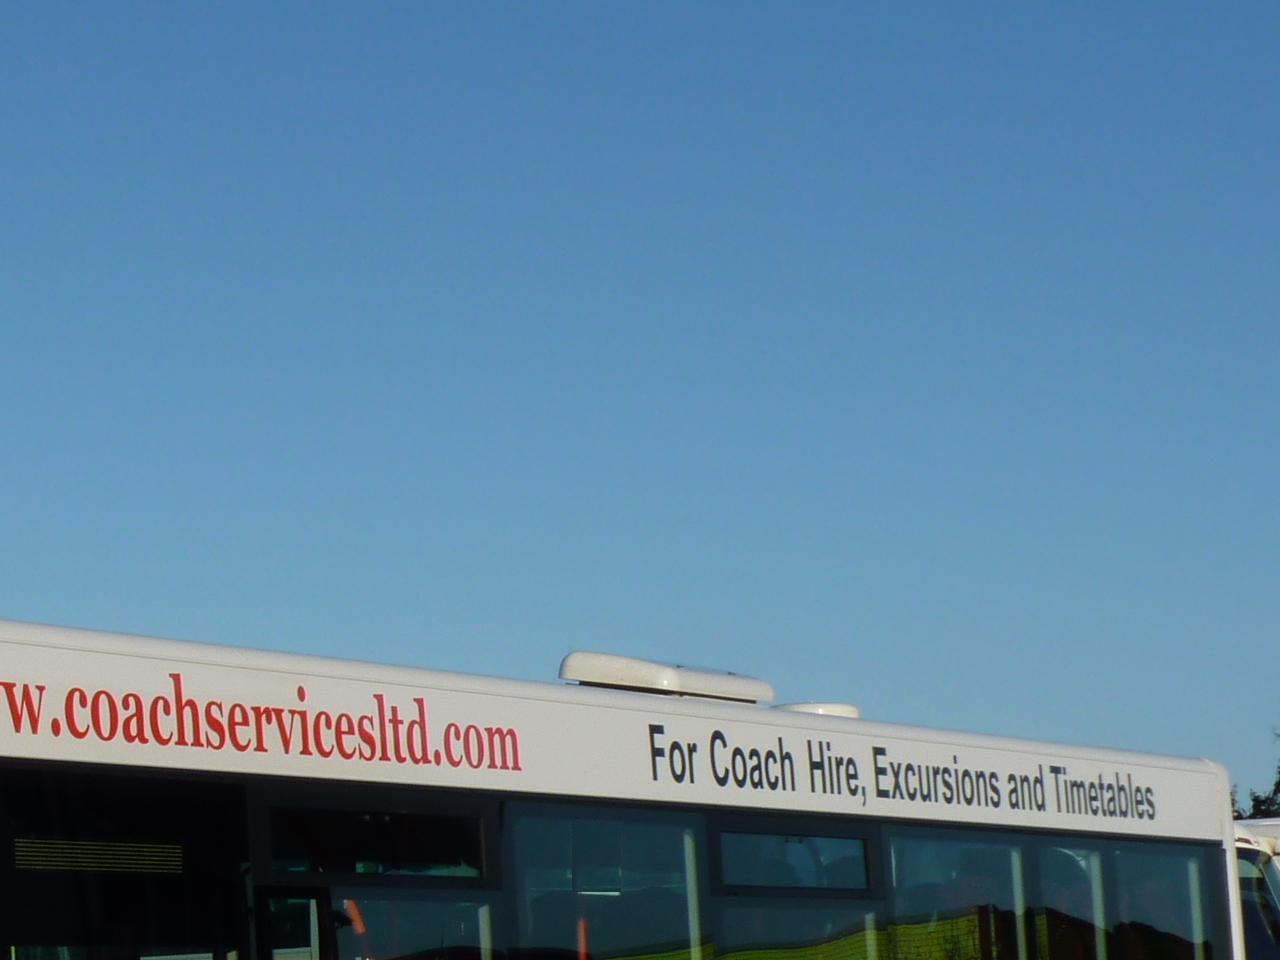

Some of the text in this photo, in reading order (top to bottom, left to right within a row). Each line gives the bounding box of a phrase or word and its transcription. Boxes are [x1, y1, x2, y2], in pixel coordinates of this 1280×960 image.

[648, 723, 1156, 821] For Coach Hire, Excursions and Timetables
